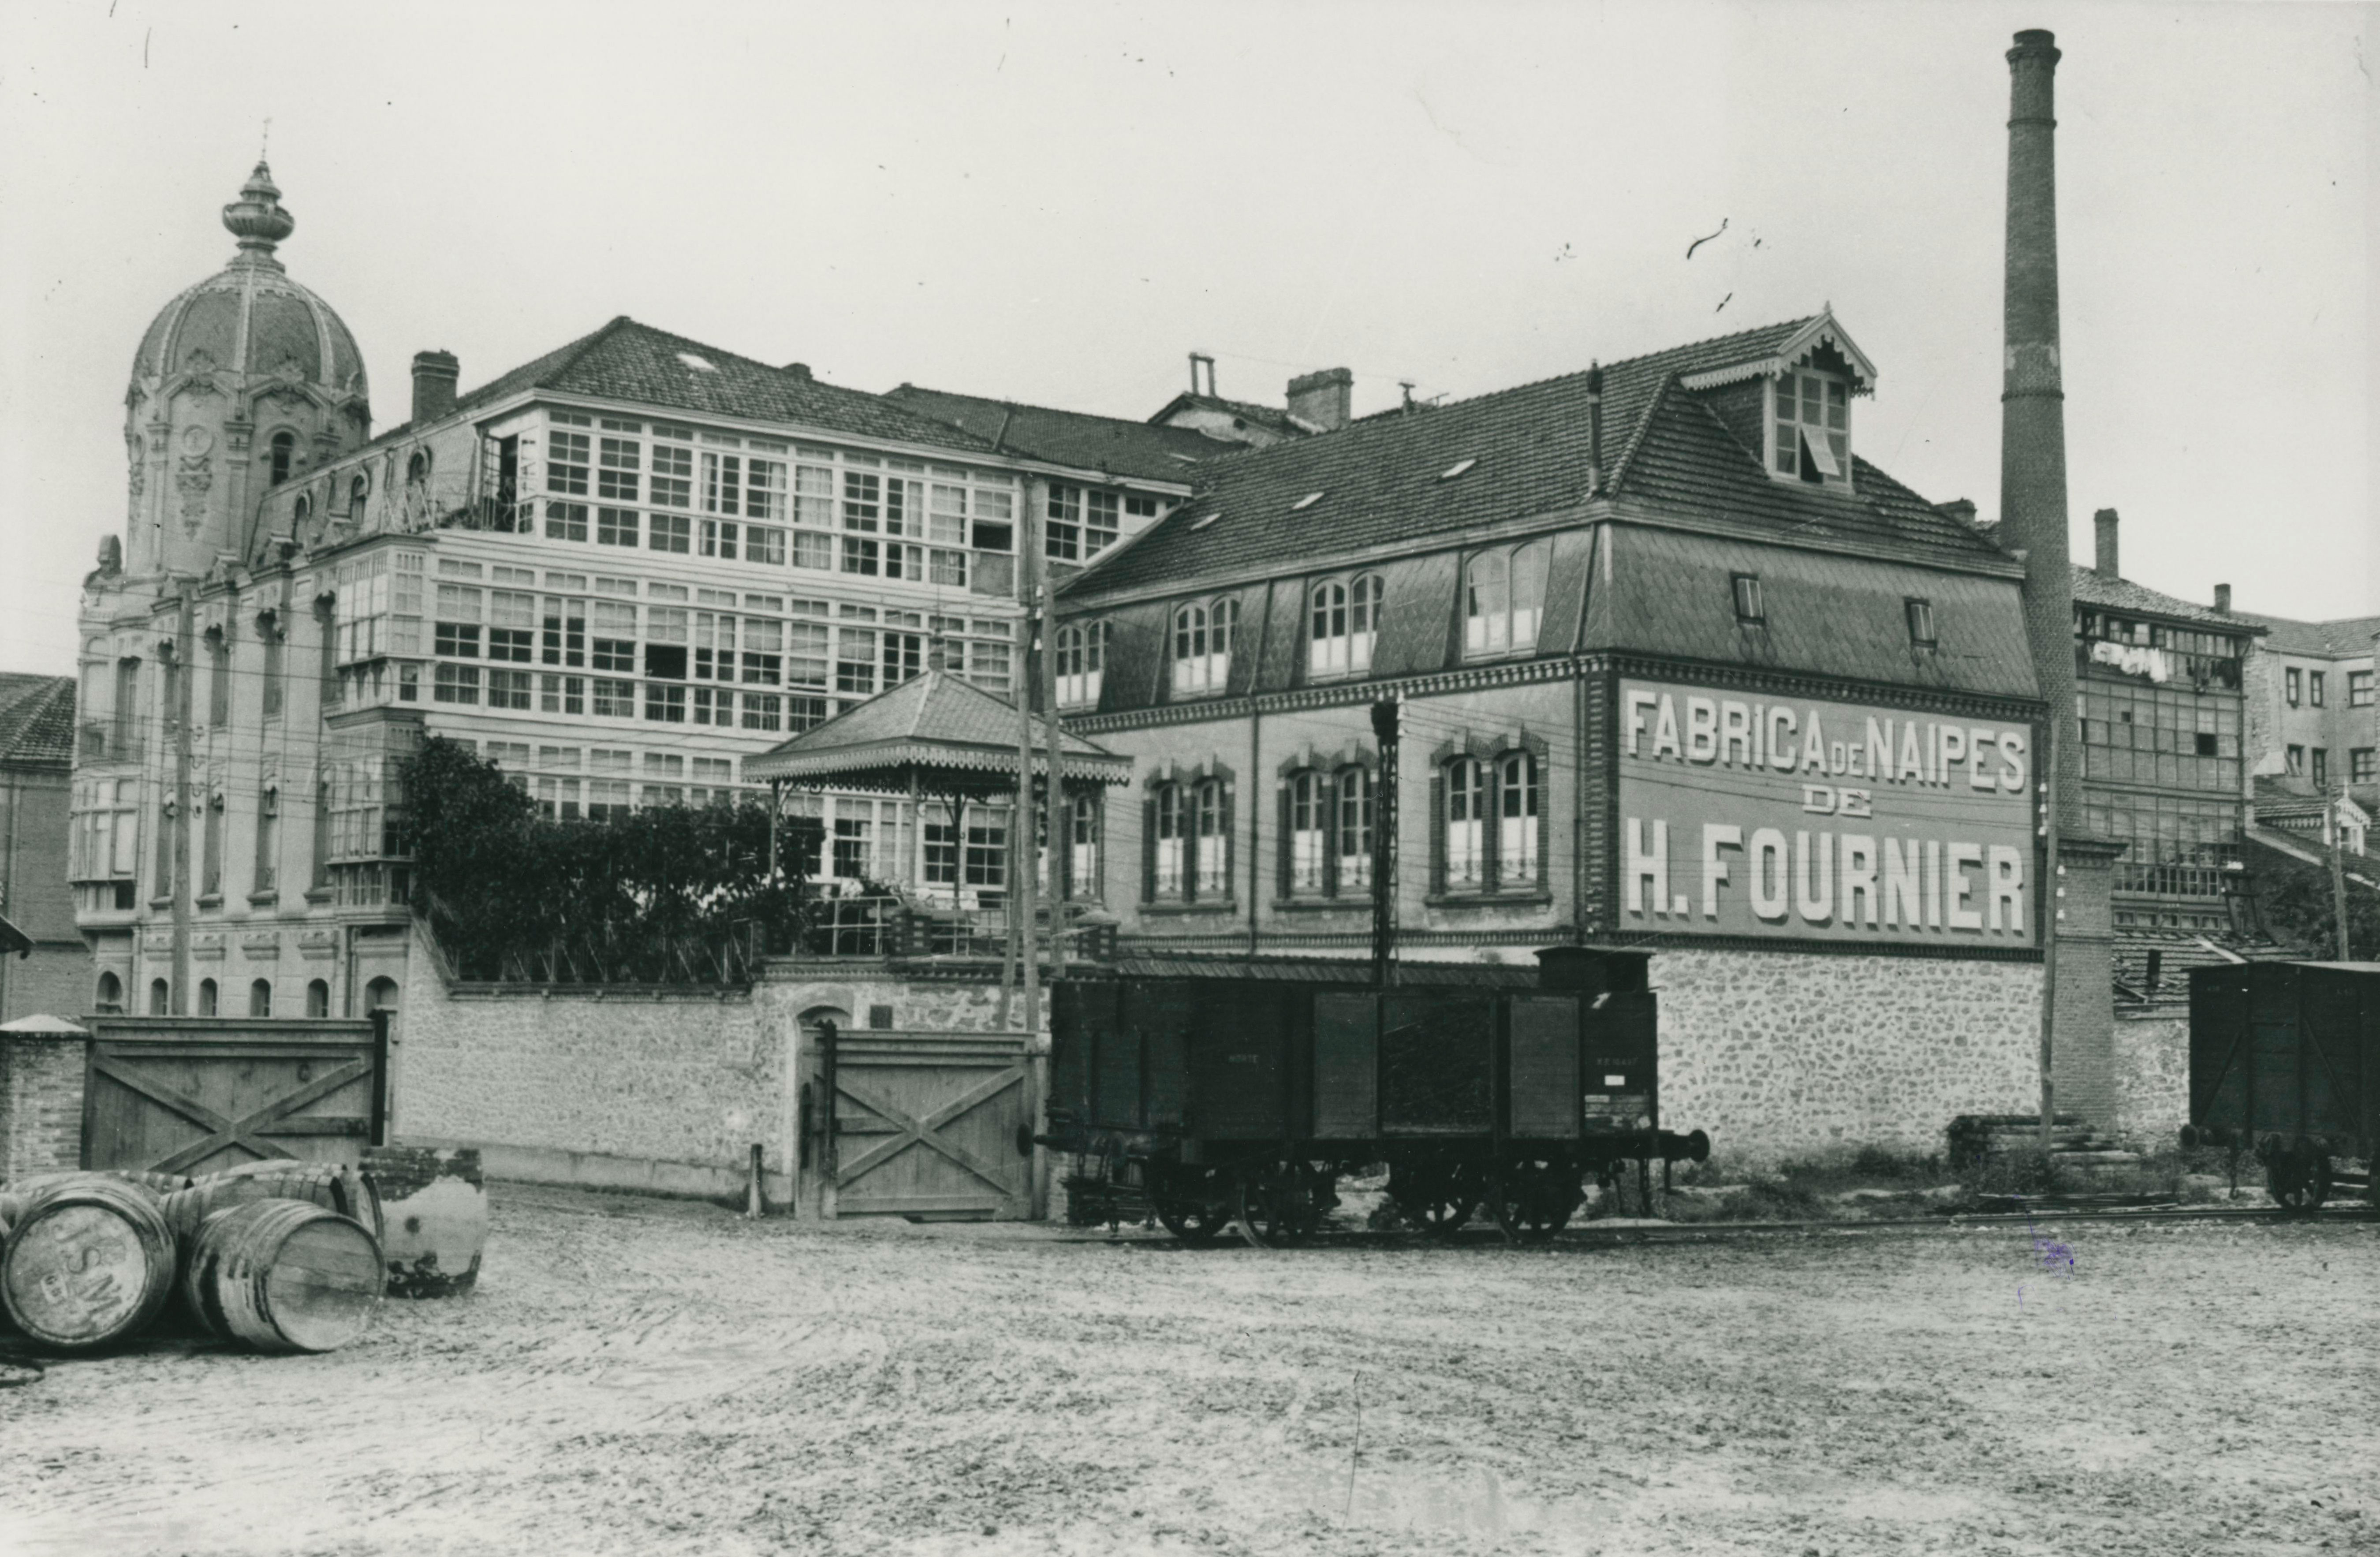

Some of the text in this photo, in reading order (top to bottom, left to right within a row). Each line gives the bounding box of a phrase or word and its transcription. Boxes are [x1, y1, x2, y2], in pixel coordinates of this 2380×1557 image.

[1626, 690, 2026, 792] FABRICA DE NAIPES
[1802, 784, 1872, 818] DE
[1627, 818, 2024, 937] H. FOURNIER
